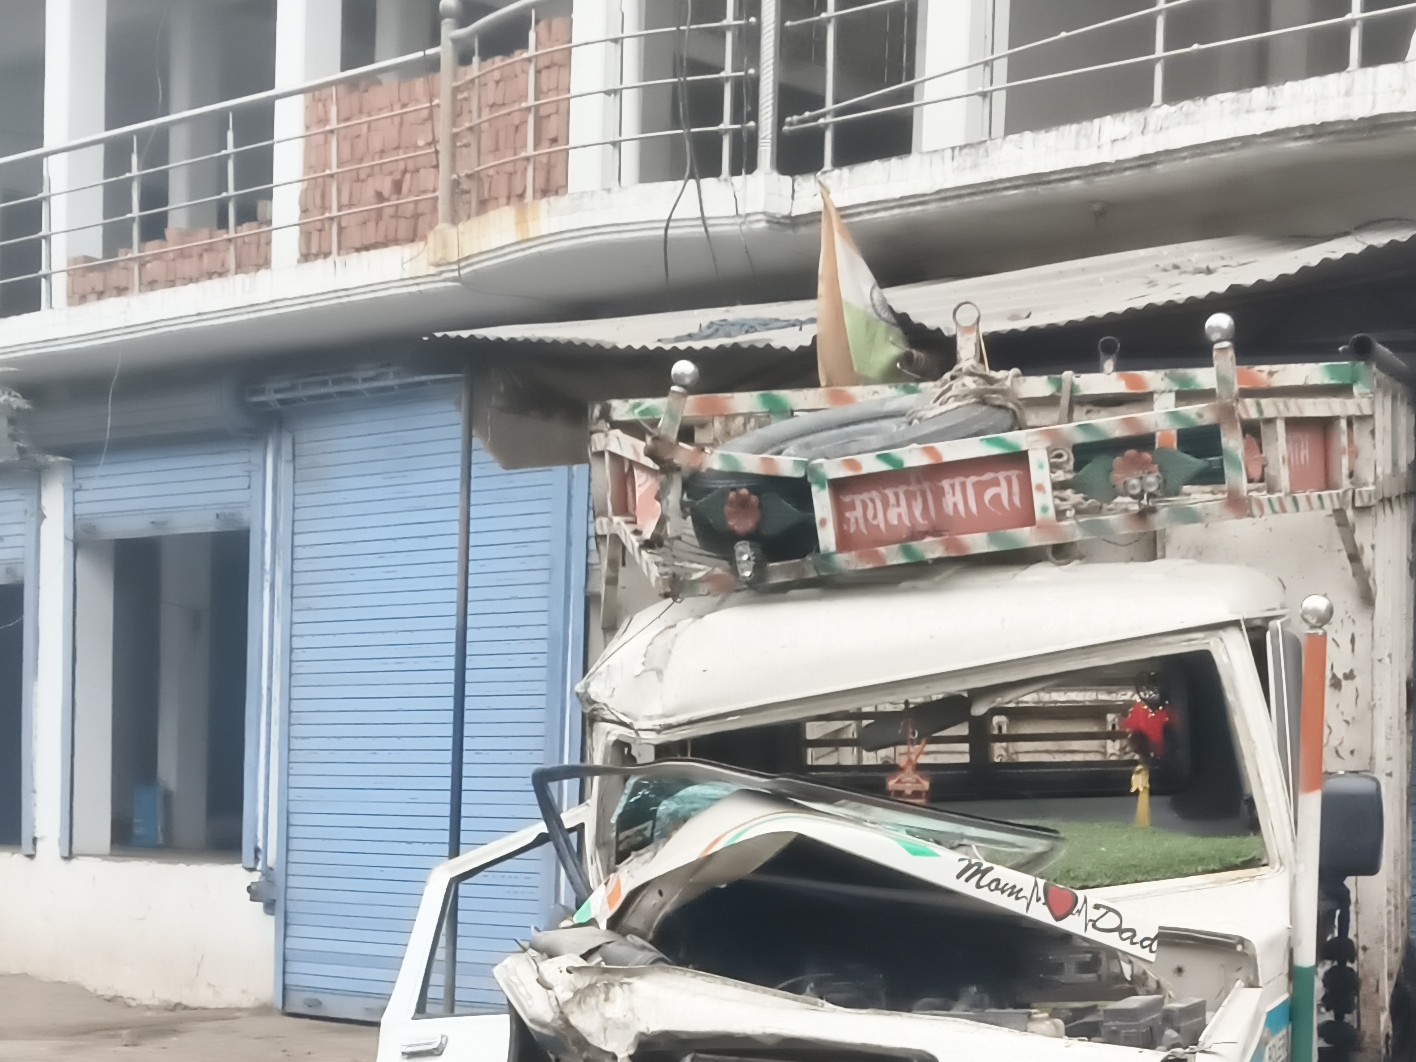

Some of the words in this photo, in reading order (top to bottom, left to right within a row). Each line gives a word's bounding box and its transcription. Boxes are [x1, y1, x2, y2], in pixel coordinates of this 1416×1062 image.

[939, 470, 1023, 519] माता
[956, 857, 1027, 901] Mom
[1090, 903, 1158, 954] Dad
